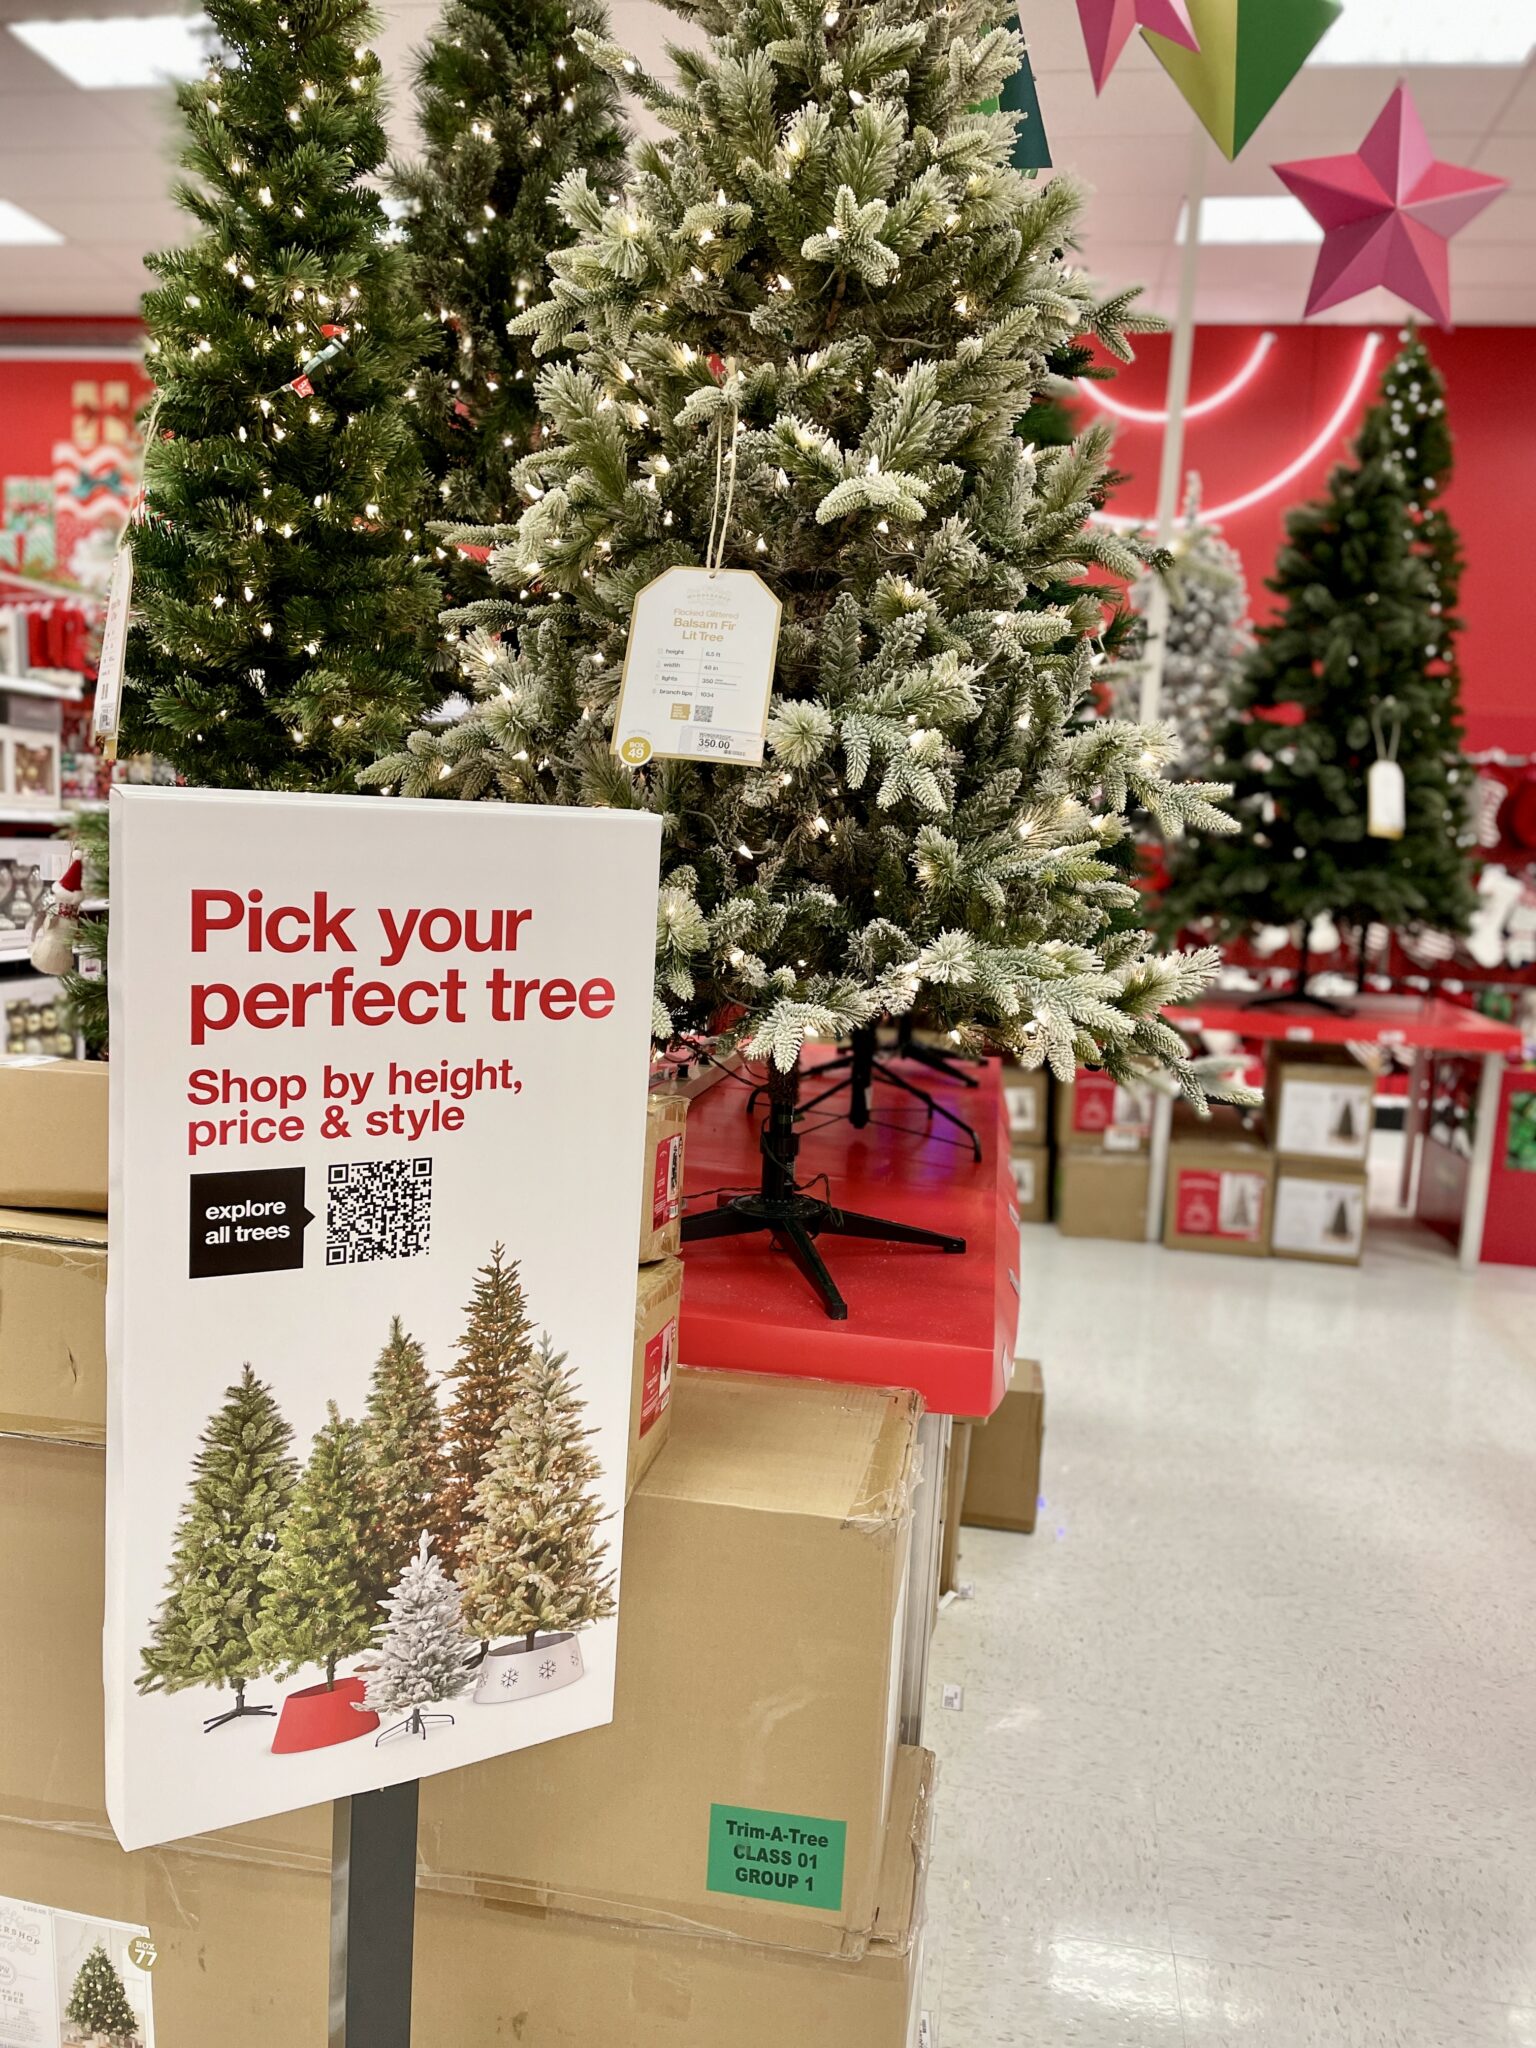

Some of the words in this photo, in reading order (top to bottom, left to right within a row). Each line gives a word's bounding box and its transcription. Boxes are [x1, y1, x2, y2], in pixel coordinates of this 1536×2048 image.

[673, 617, 718, 630] Balsam
[721, 620, 737, 631] Fir
[682, 630, 697, 641] Lit
[699, 631, 724, 642] Tree
[659, 688, 681, 696] branch
[628, 748, 644, 759] 49
[698, 738, 731, 750] 350.00
[191, 888, 357, 954] Pick
[378, 907, 533, 967] your
[190, 966, 468, 1046] perfect
[485, 967, 616, 1023] tree
[187, 1068, 308, 1110] Shop
[322, 1064, 375, 1106] by
[388, 1058, 524, 1098] height,
[187, 1109, 305, 1157] price
[319, 1104, 352, 1140] &
[366, 1099, 466, 1142] style
[205, 1199, 287, 1223] explore
[204, 1225, 231, 1245] all
[234, 1224, 291, 1242] trees
[725, 1819, 830, 1848] Trim-A-Tree
[733, 1843, 793, 1866] CLASS
[797, 1852, 818, 1870] 01
[735, 1866, 799, 1889] GROUP
[804, 1875, 814, 1892] 1
[135, 1940, 155, 1951] BOX
[134, 1948, 158, 1967] 77
